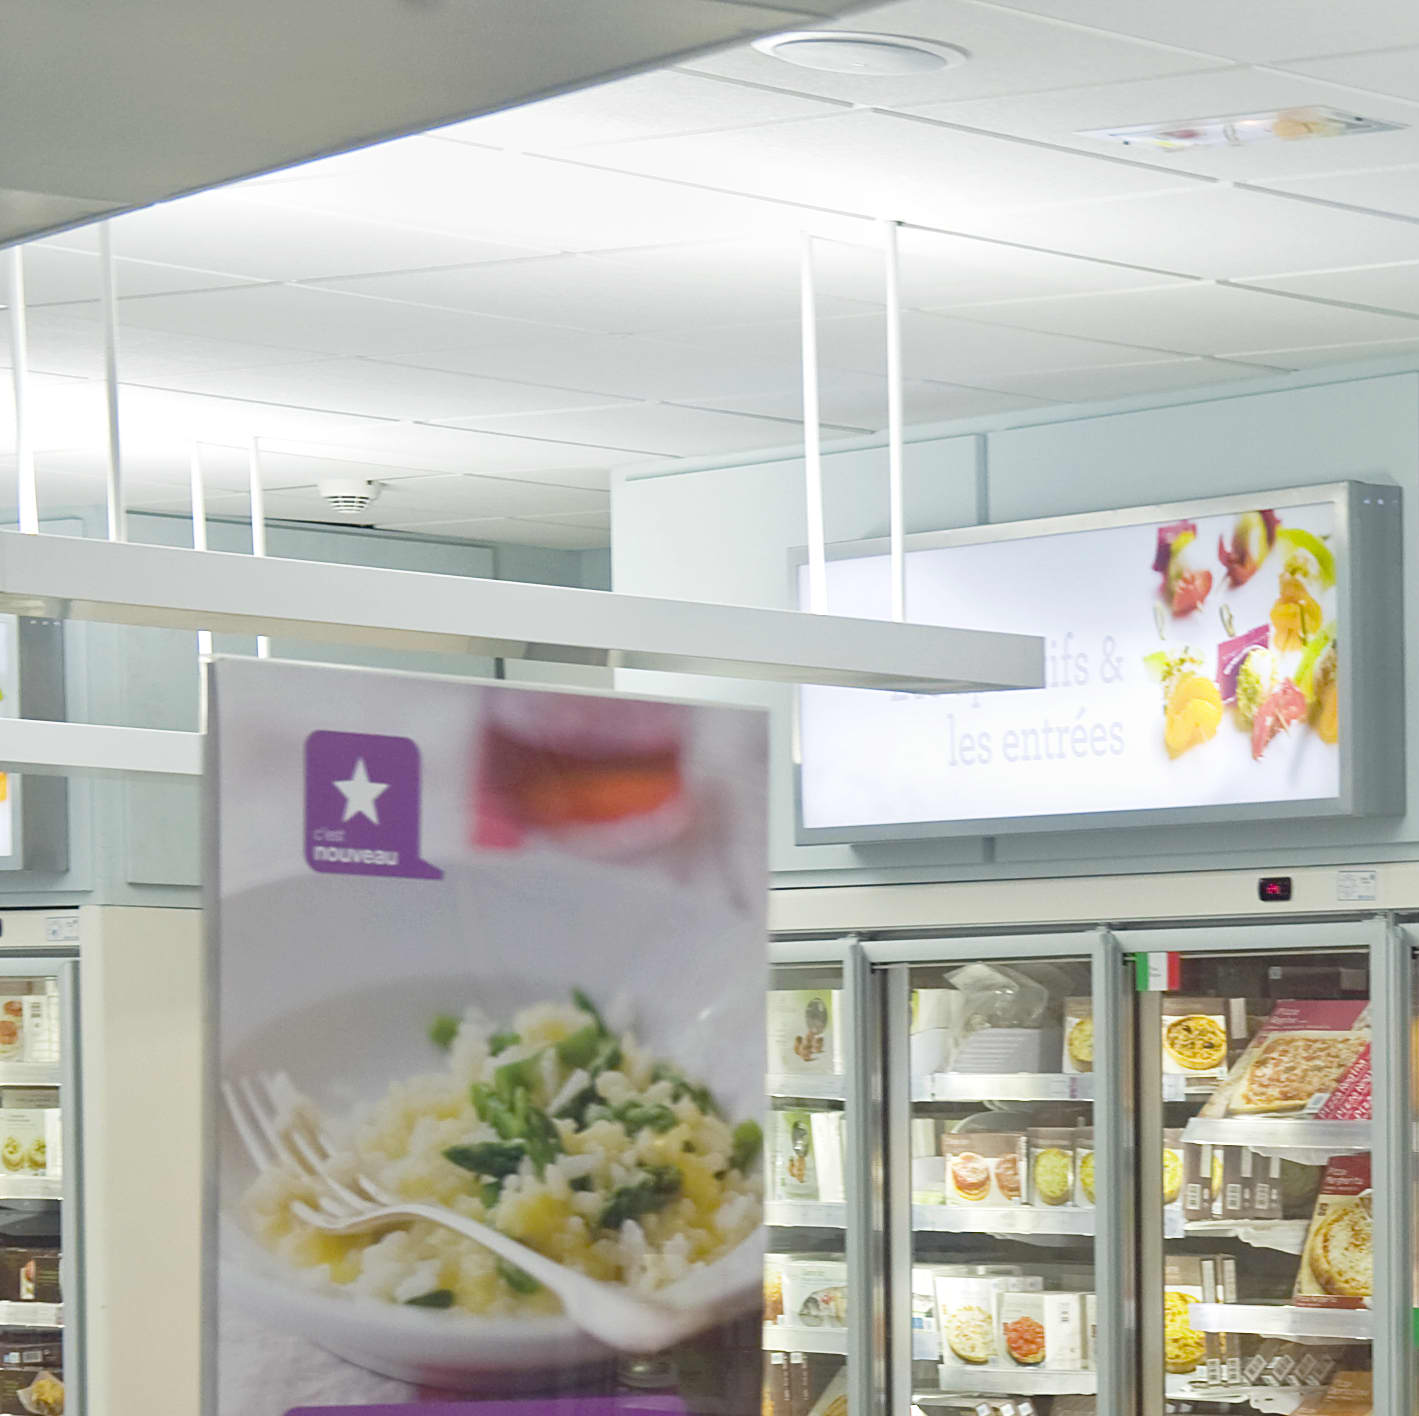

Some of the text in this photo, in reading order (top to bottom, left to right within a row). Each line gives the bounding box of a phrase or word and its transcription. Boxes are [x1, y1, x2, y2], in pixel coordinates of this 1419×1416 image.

[1099, 633, 1125, 685] &
[947, 706, 1126, 767] les entrées
[313, 846, 399, 866] nouveau
